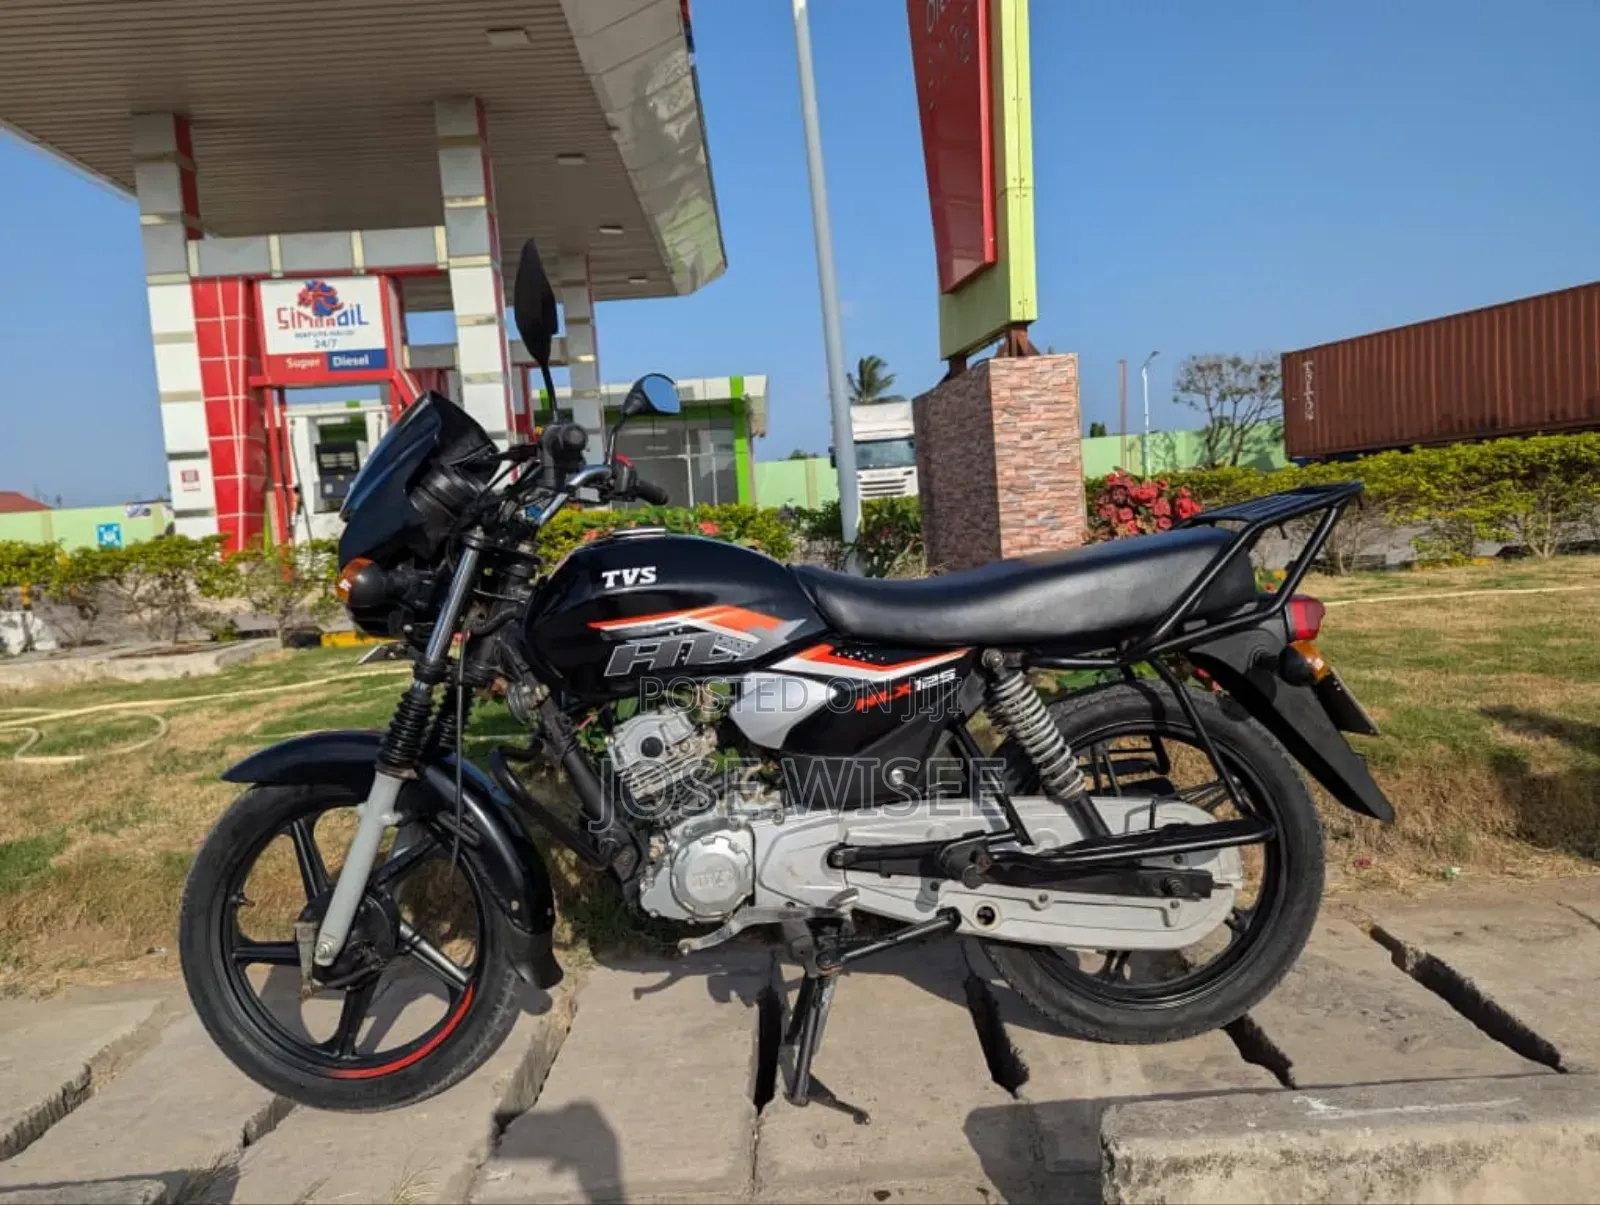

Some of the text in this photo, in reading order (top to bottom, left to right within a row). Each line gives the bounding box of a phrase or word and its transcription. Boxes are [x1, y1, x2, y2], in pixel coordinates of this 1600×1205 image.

[314, 338, 337, 348] 24/7
[286, 354, 369, 369] Super Diesel
[602, 566, 657, 589] TVS
[913, 668, 956, 692] 125
